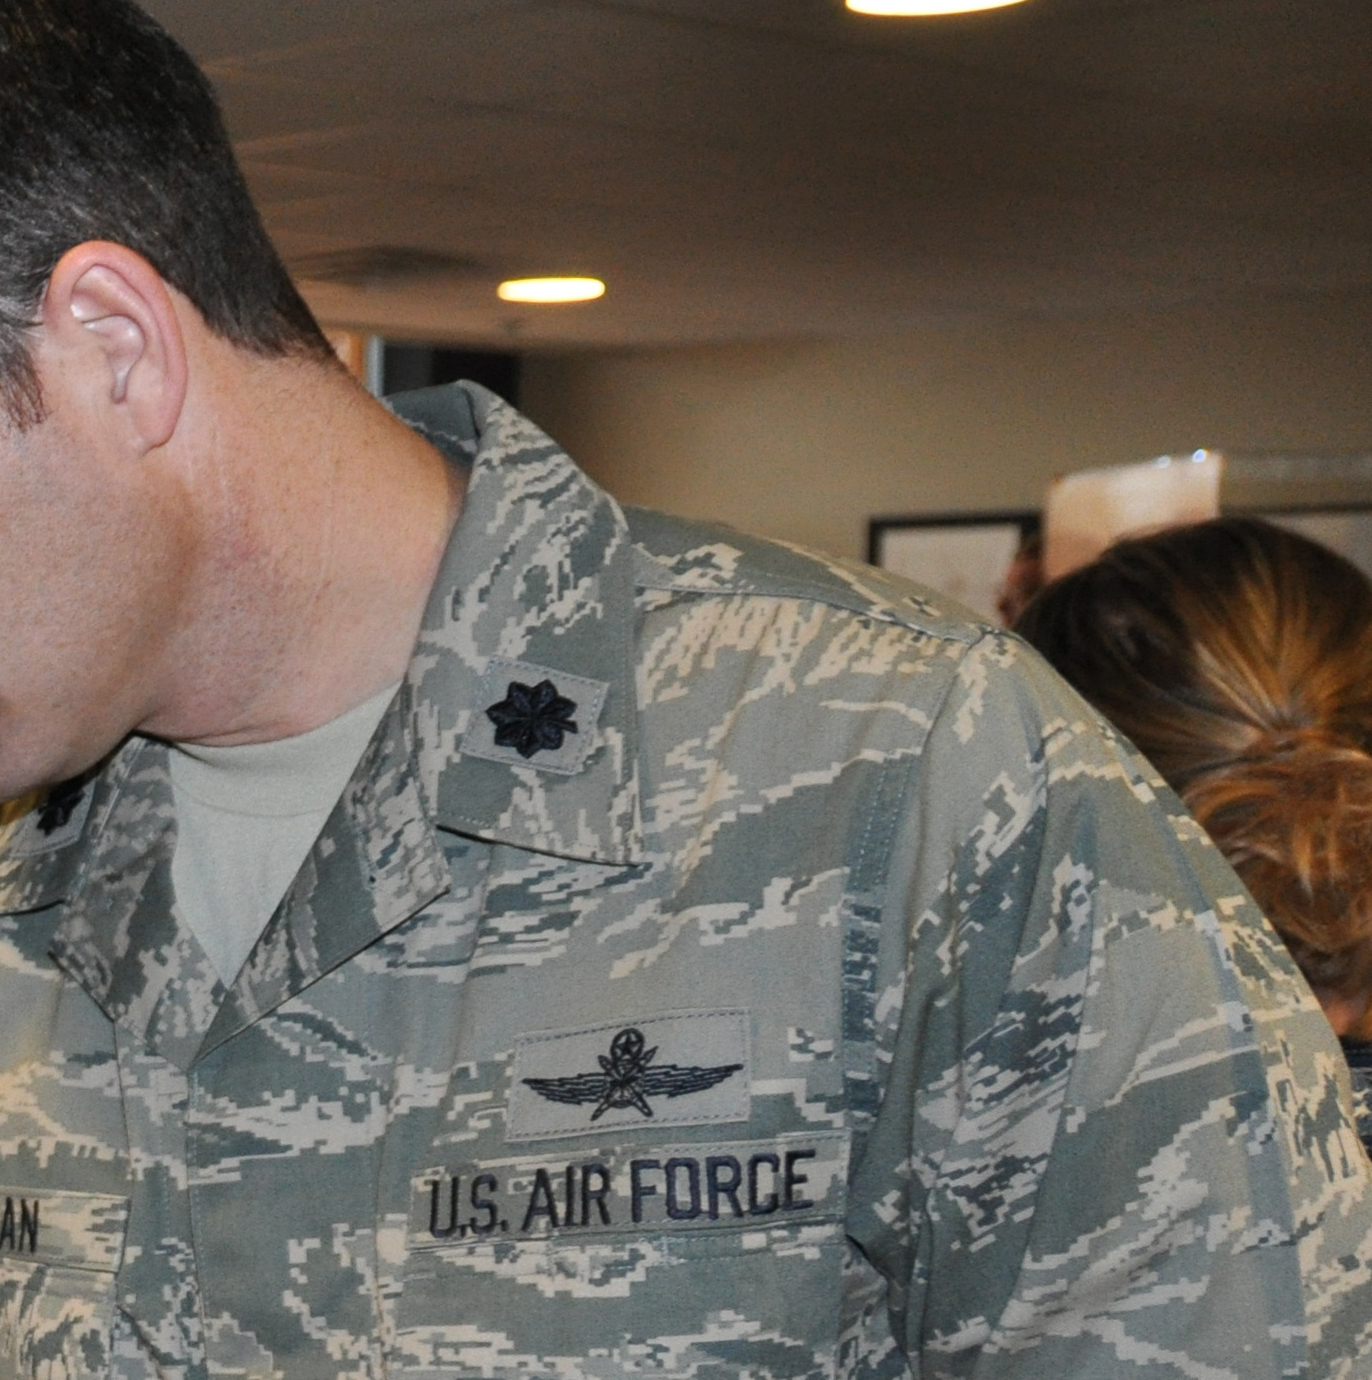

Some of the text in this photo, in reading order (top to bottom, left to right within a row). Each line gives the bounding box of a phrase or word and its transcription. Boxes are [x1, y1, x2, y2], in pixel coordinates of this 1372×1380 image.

[429, 1149, 816, 1238] U.S. AIR FORCE
